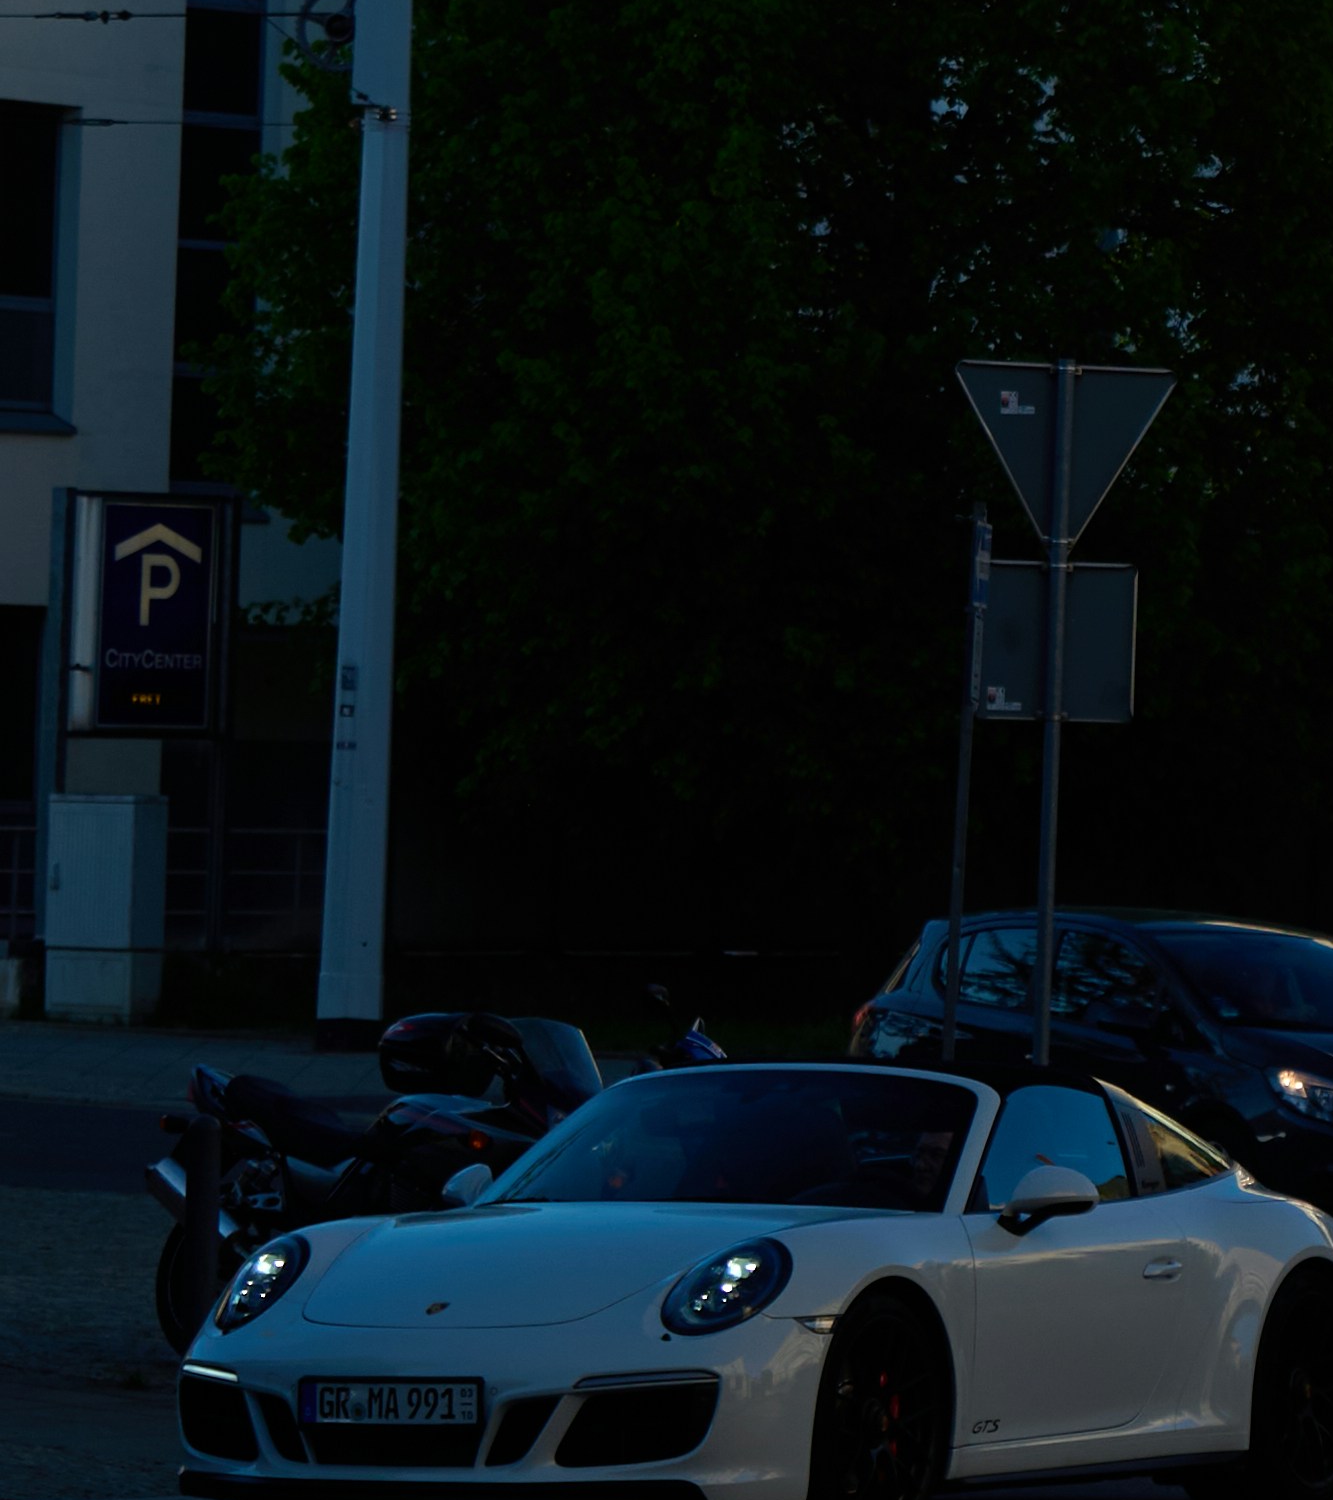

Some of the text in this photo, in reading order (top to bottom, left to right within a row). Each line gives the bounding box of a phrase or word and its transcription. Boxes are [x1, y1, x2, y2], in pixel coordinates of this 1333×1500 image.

[138, 552, 182, 628] P
[319, 1386, 456, 1421] GR MA 991
[971, 1418, 1001, 1434] GTS
